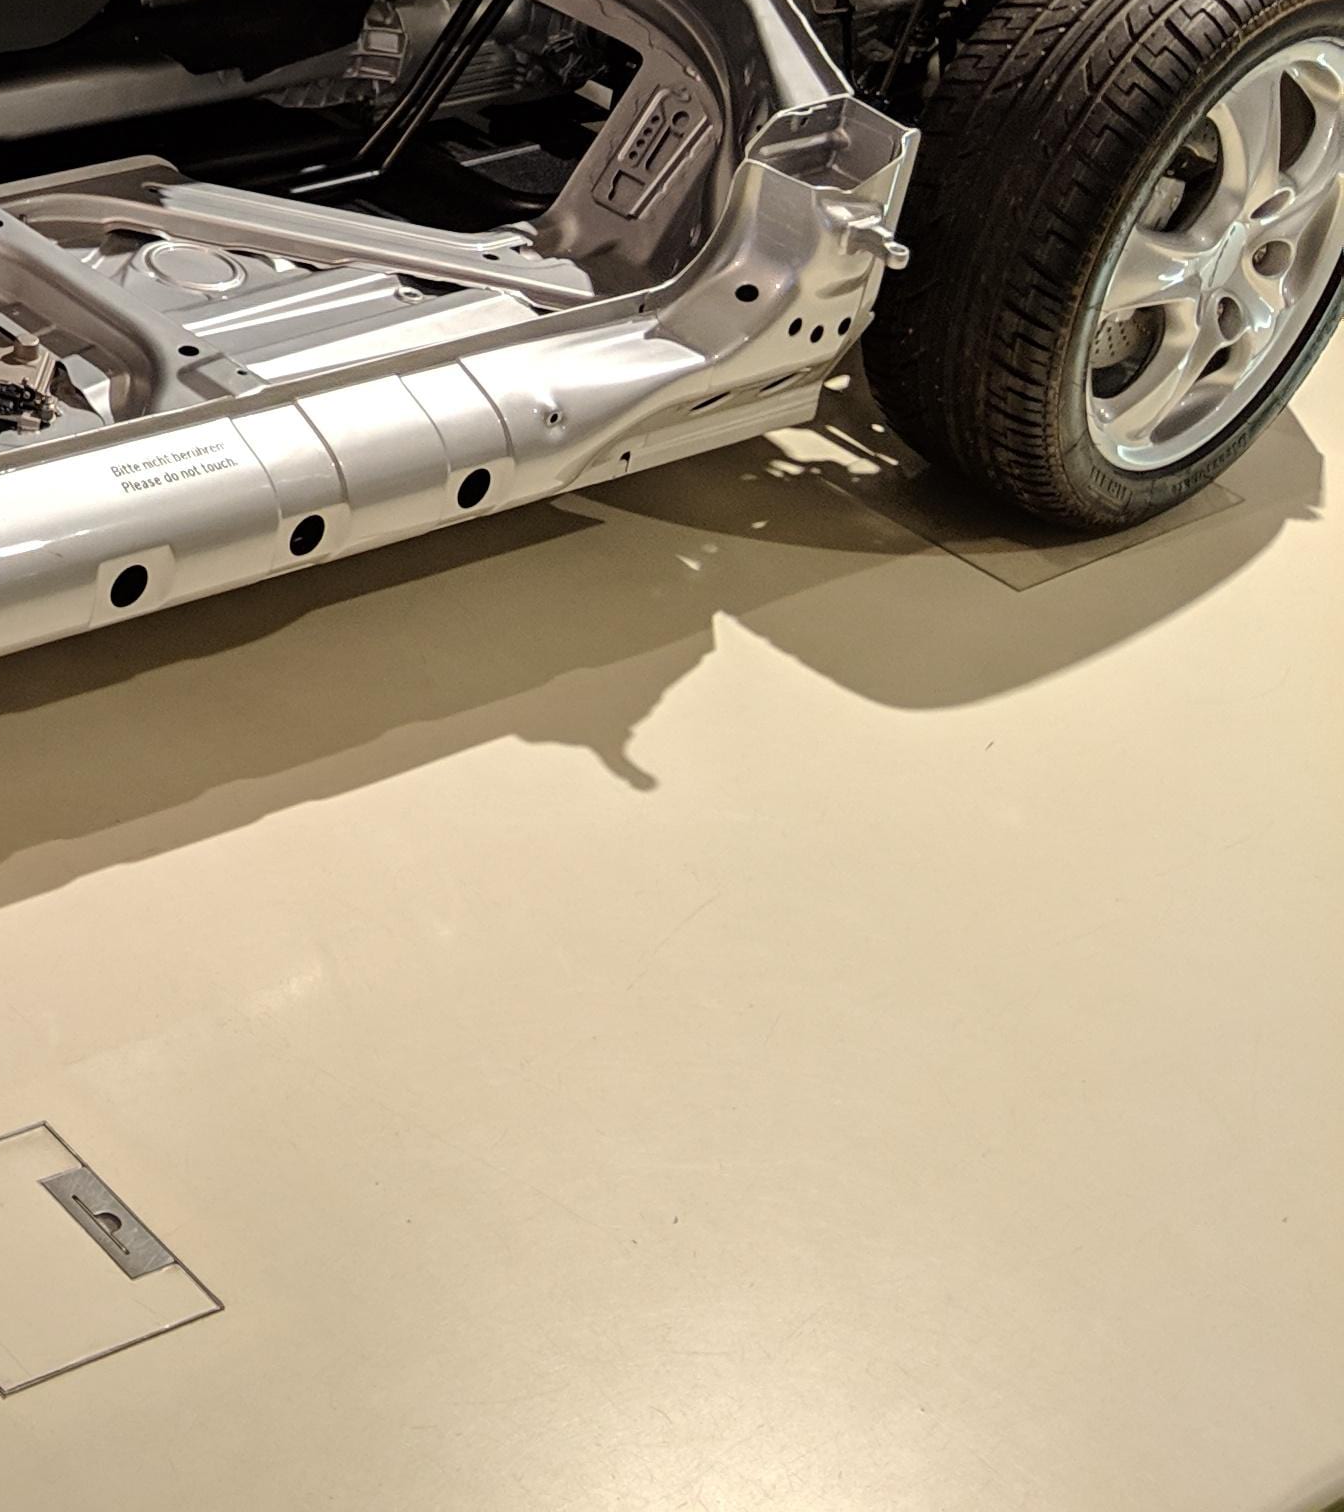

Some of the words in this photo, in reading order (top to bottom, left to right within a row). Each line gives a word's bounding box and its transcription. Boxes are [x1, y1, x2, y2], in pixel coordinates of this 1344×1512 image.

[110, 464, 142, 478] Bitte
[141, 454, 171, 471] nicht
[120, 476, 162, 494] Please
[163, 471, 180, 484] do
[180, 465, 201, 480] not
[200, 456, 239, 474] touch.
